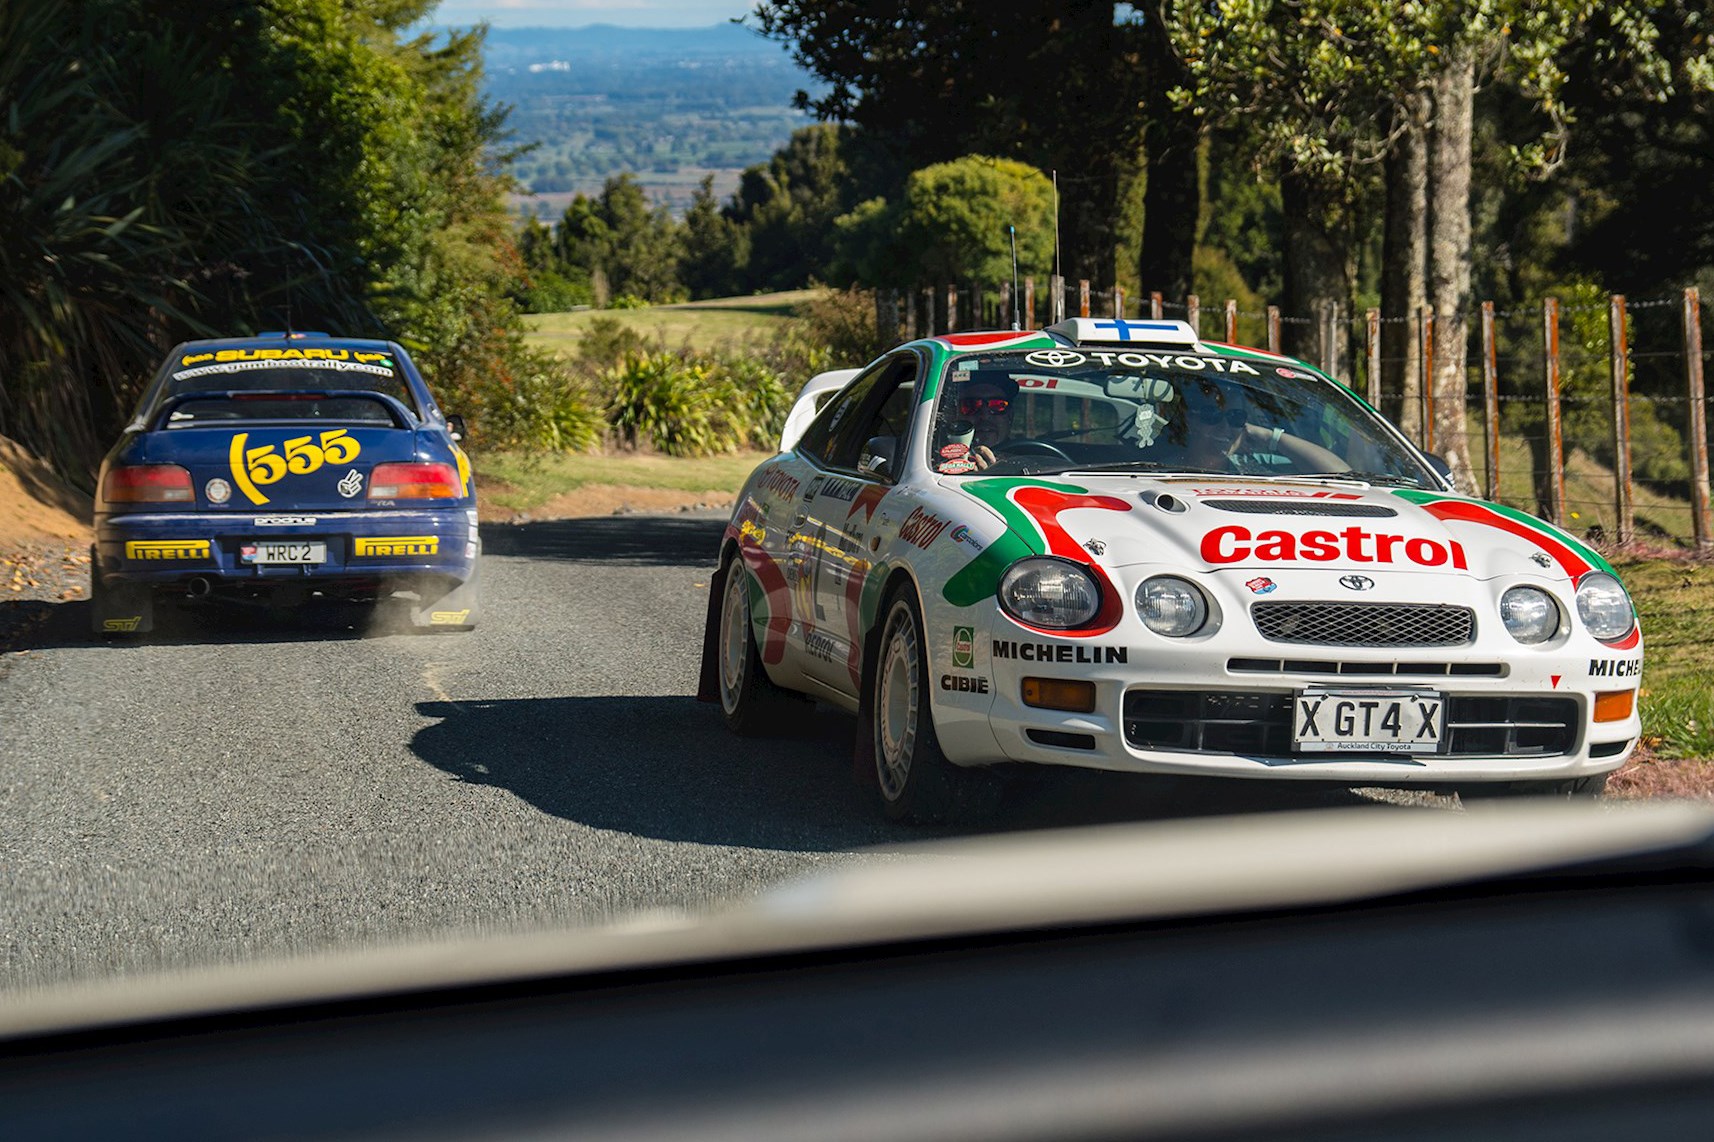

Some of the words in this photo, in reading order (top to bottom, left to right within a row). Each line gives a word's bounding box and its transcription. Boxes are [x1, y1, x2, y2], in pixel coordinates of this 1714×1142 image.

[215, 349, 349, 361] SUBARU
[1091, 352, 1261, 376] TOYOTA
[172, 359, 394, 381] www.gumbootrally.com
[899, 505, 952, 550] Castrol
[126, 540, 210, 560] PIRELLI
[355, 535, 440, 556] PIRELLI
[1200, 525, 1468, 570] Castrol
[993, 640, 1128, 664] MICHELIN
[1588, 659, 1641, 677] MICHE
[1299, 701, 1322, 736] X
[1335, 702, 1402, 737] GT4
[1416, 703, 1439, 738] X
[1337, 742, 1369, 750] Auckland
[1370, 743, 1385, 751] City
[1387, 743, 1411, 751] Toyota
